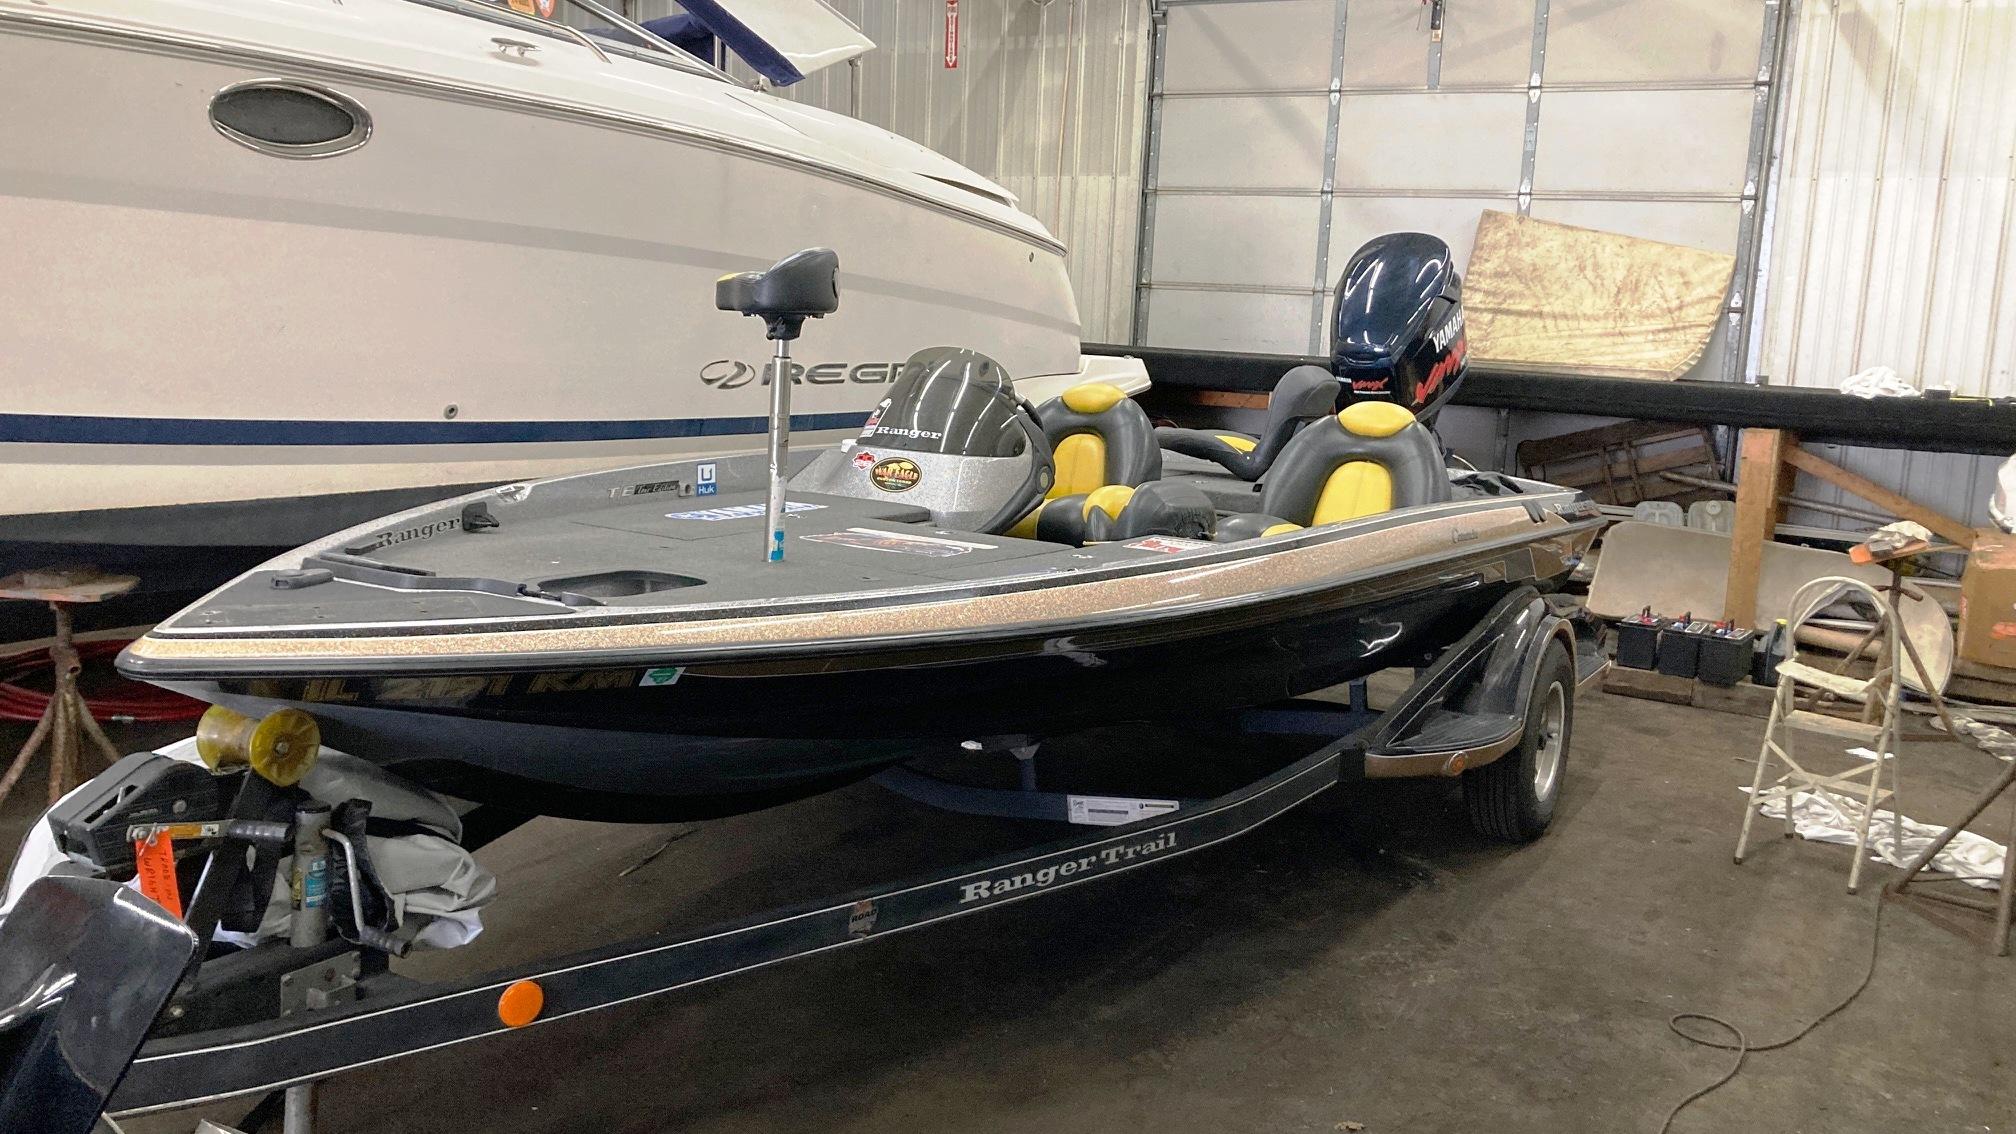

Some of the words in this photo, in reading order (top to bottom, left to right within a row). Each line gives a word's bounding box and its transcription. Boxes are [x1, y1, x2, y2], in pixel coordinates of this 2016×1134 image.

[876, 426, 942, 440] Ranger
[698, 486, 715, 494] Huk
[376, 518, 460, 548] Ranger
[959, 855, 1097, 904] Ranger
[1101, 832, 1177, 864] Trail
